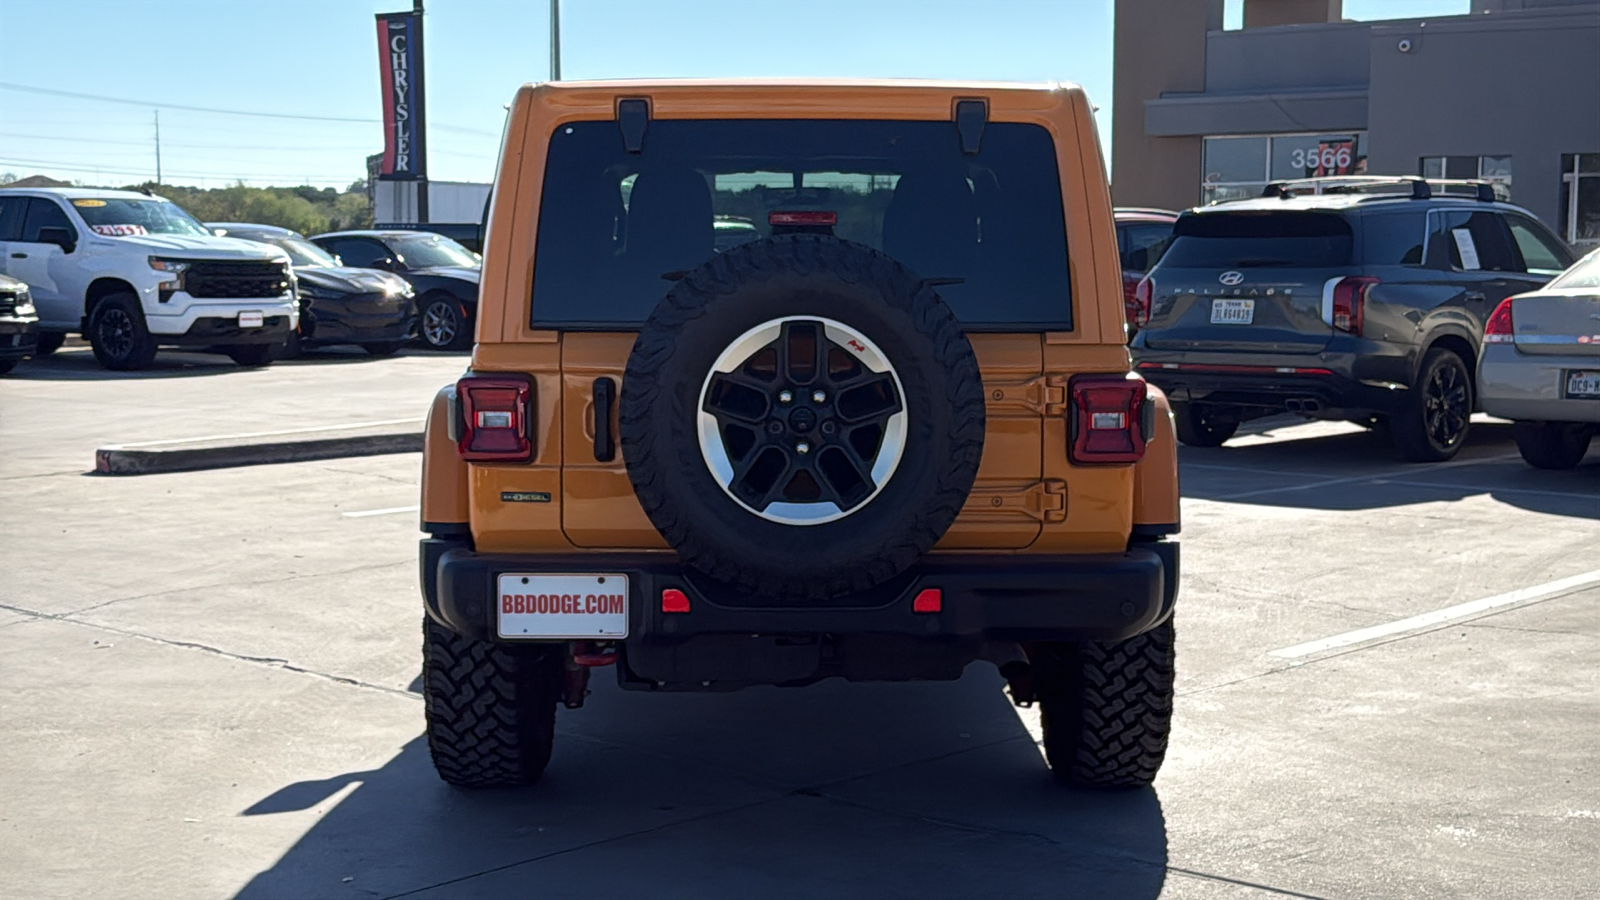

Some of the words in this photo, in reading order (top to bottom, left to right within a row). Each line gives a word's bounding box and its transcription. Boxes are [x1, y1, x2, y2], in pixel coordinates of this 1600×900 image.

[391, 35, 409, 171] CHRYSLER
[1291, 147, 1351, 169] 3566
[502, 594, 624, 614] BBDODGE.COM
